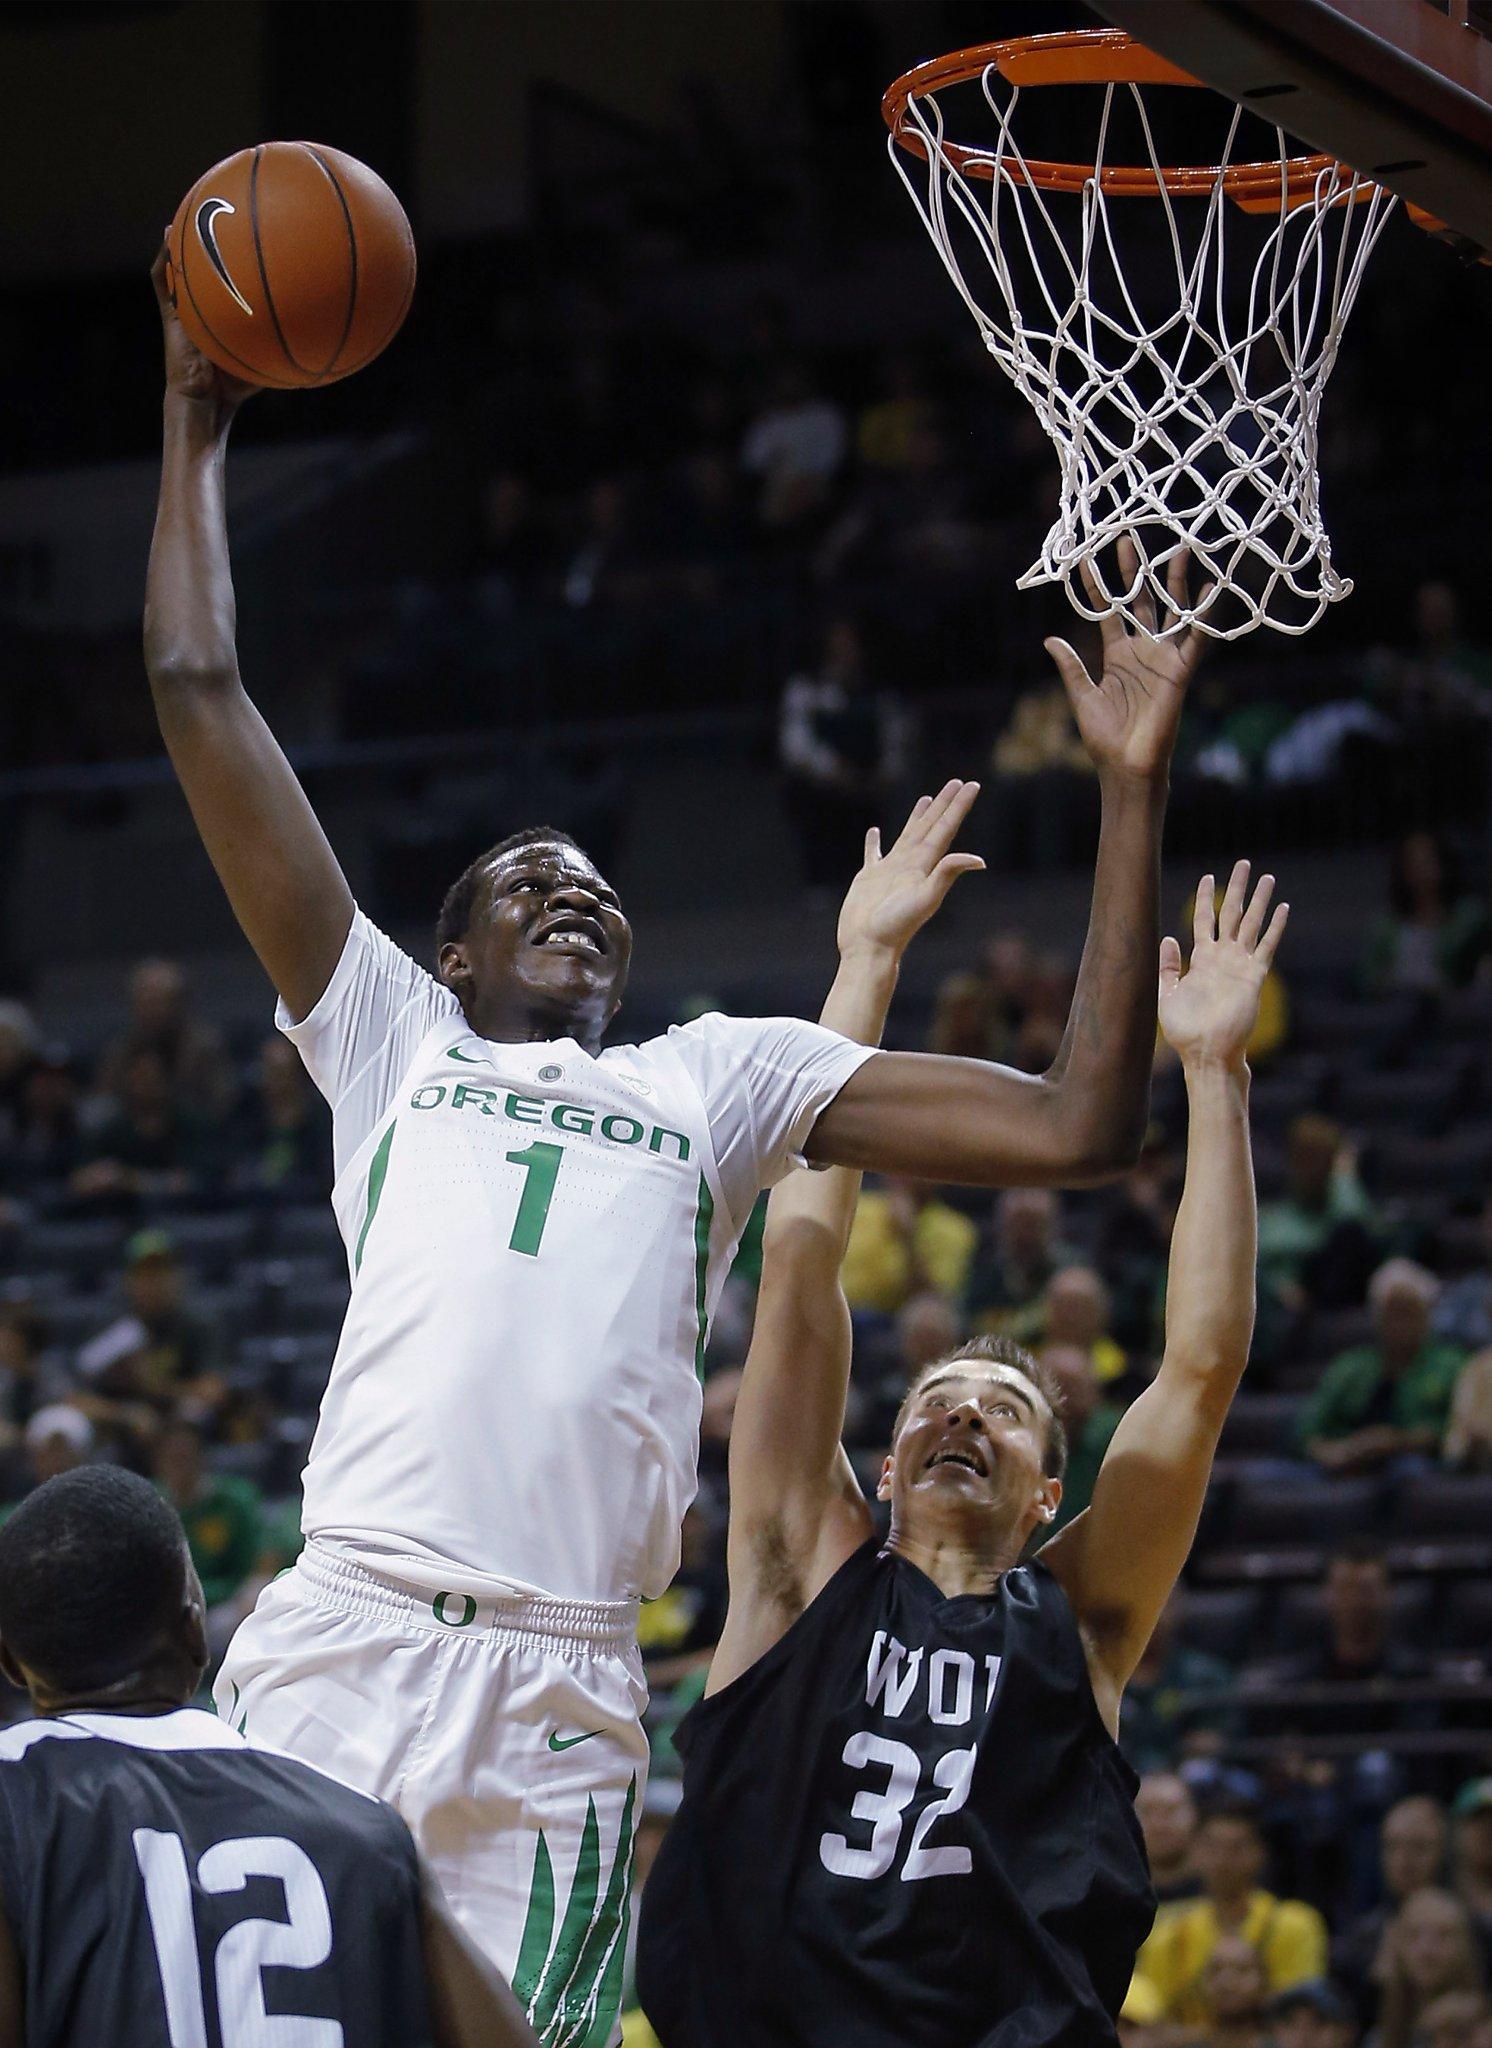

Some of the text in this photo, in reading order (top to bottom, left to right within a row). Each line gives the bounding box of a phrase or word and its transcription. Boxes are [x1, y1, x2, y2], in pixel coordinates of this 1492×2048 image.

[410, 1083, 691, 1162] OREGON
[505, 1140, 565, 1258] 1
[432, 1590, 477, 1628] O
[819, 1730, 977, 1882] 32
[132, 1827, 345, 2048] 12
